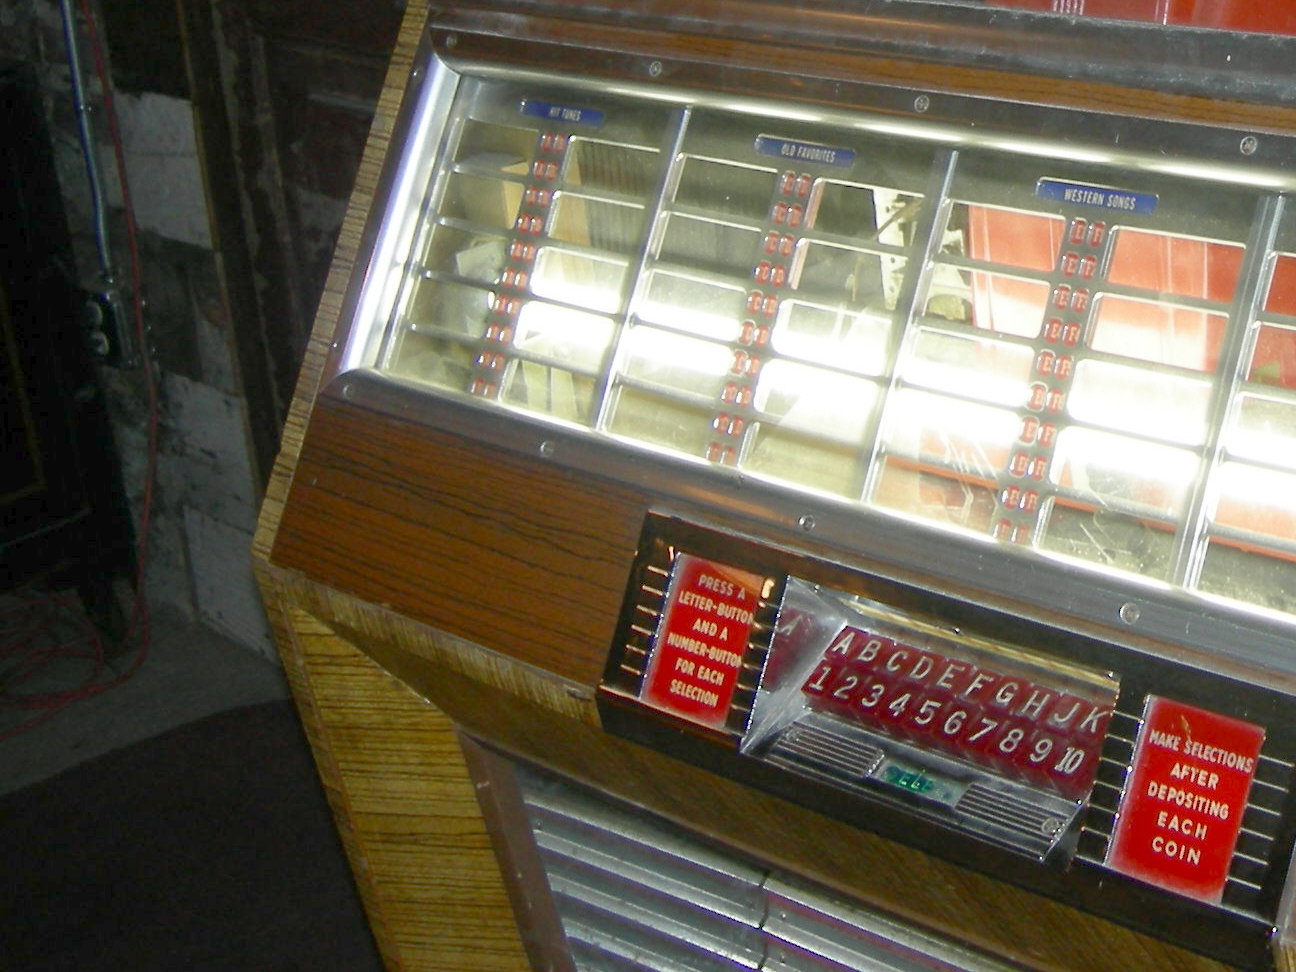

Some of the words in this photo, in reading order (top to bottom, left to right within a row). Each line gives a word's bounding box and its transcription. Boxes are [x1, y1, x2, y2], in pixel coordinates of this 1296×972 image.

[781, 143, 796, 157] OLD
[796, 146, 836, 163] FAVORITES
[1064, 188, 1104, 206] WESTERN
[1107, 194, 1137, 211] SONGS
[698, 574, 734, 596] PRESS
[737, 588, 746, 600] A
[678, 590, 754, 625] LETTER-BUTTON
[692, 618, 718, 636] AND
[719, 627, 728, 642] A
[667, 632, 742, 668] NUMBER-BUTTON
[675, 657, 694, 676] FOR
[697, 665, 725, 686] EACH
[832, 632, 855, 655] A
[858, 640, 882, 661] B
[887, 650, 908, 672] C
[909, 658, 934, 679] D
[936, 666, 965, 689] E
[964, 673, 994, 696] F
[995, 682, 1019, 704] G
[1020, 693, 1050, 717] H
[1054, 702, 1080, 723] J
[1080, 708, 1109, 733] K
[669, 679, 719, 708] SELECTION
[808, 667, 831, 691] 1
[834, 677, 858, 699] 2
[861, 684, 884, 708] 3
[889, 693, 912, 717] 4
[915, 701, 942, 725] 5
[944, 711, 968, 734] 6
[968, 719, 998, 741] 7
[999, 728, 1024, 753] 8
[1029, 739, 1053, 763] 9
[1054, 746, 1086, 774] 10
[1149, 729, 1181, 751] MAKE
[1184, 739, 1254, 774] SELECTIONS
[1170, 762, 1219, 791] AFTER
[1147, 781, 1229, 820] DEPOSITING
[1157, 811, 1208, 841] EACH
[1152, 836, 1201, 865] COIN
